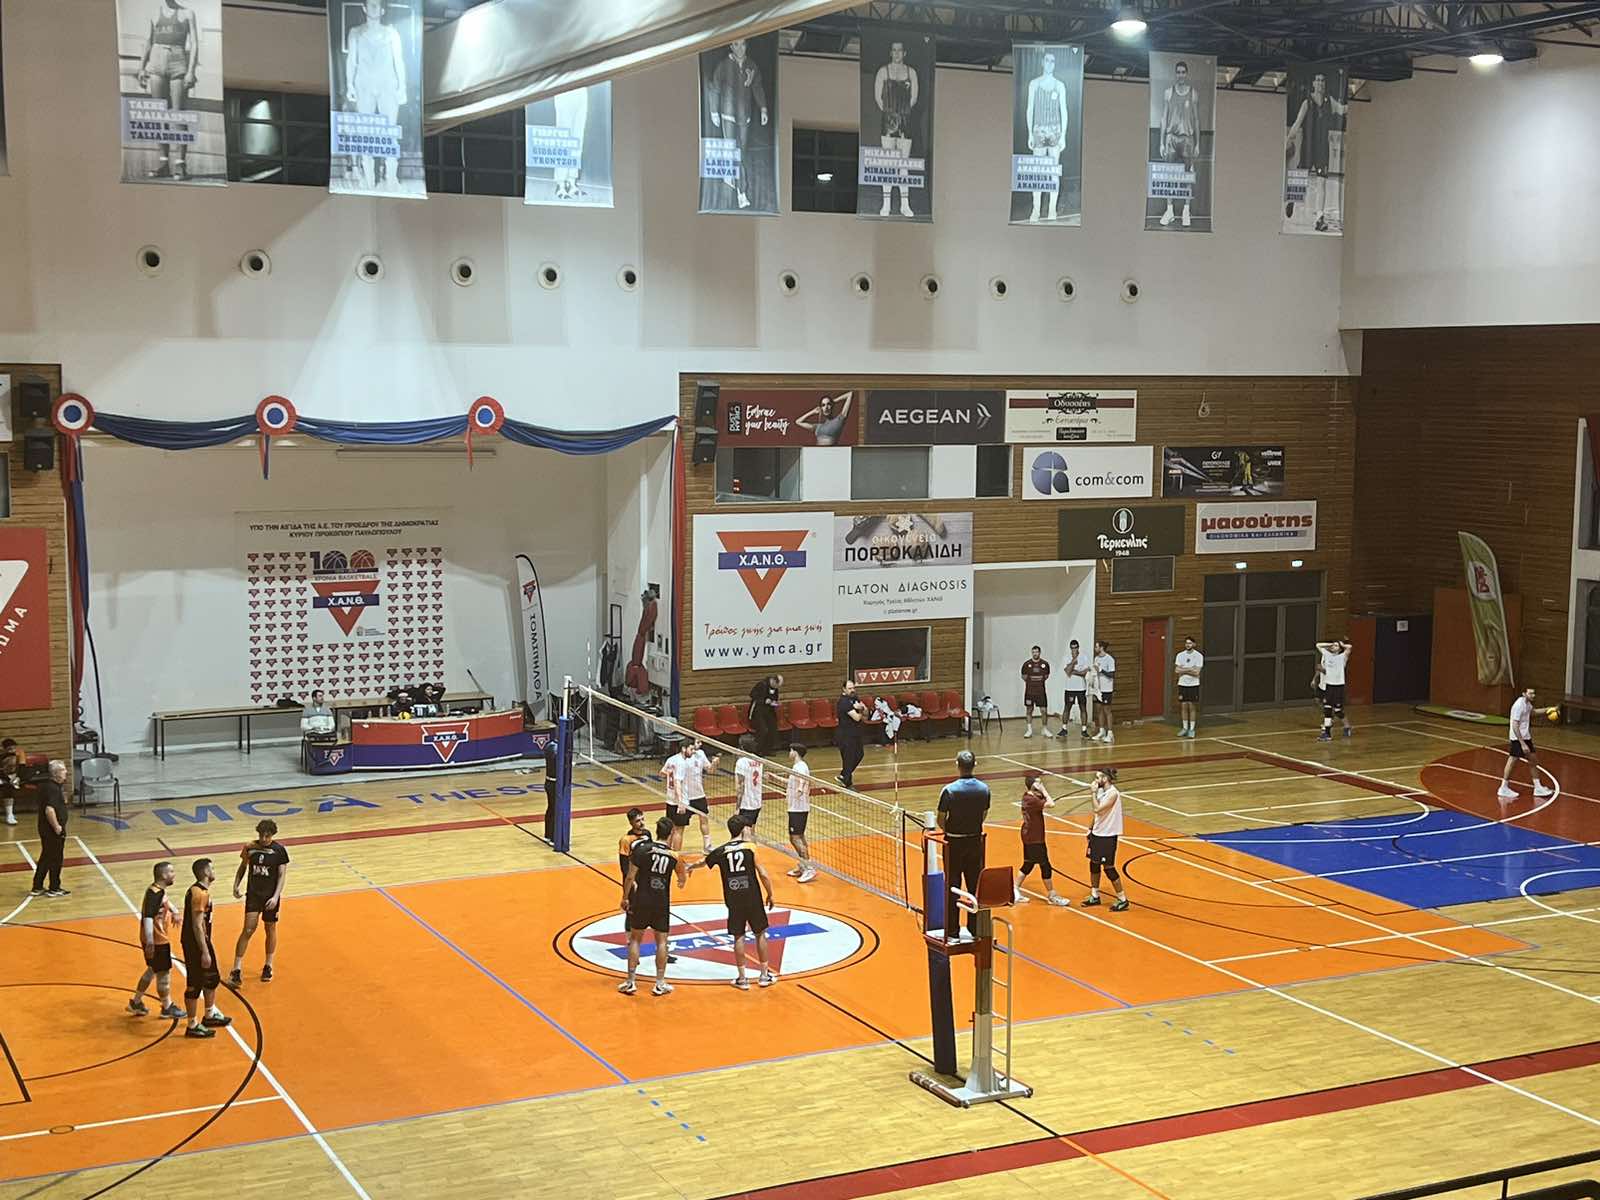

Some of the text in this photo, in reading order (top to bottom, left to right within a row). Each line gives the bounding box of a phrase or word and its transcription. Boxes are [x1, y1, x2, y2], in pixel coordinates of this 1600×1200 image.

[746, 404, 777, 419] Embrace
[879, 409, 971, 424] AEGEAN
[745, 419, 763, 436] your
[764, 417, 790, 436] beauty
[1075, 472, 1144, 487] com&com
[303, 522, 316, 530] ΤΗΣ
[380, 520, 392, 528] ΤΗΣ
[739, 554, 788, 567] Χ.Α.Ν.Θ.
[845, 543, 962, 563] ΠΟΡΤΟΚΑΛΙΔΗ
[704, 641, 823, 659] www.ymca.gr
[80, 793, 381, 831] YMCA
[651, 853, 670, 875] 20
[726, 851, 746, 873] 12
